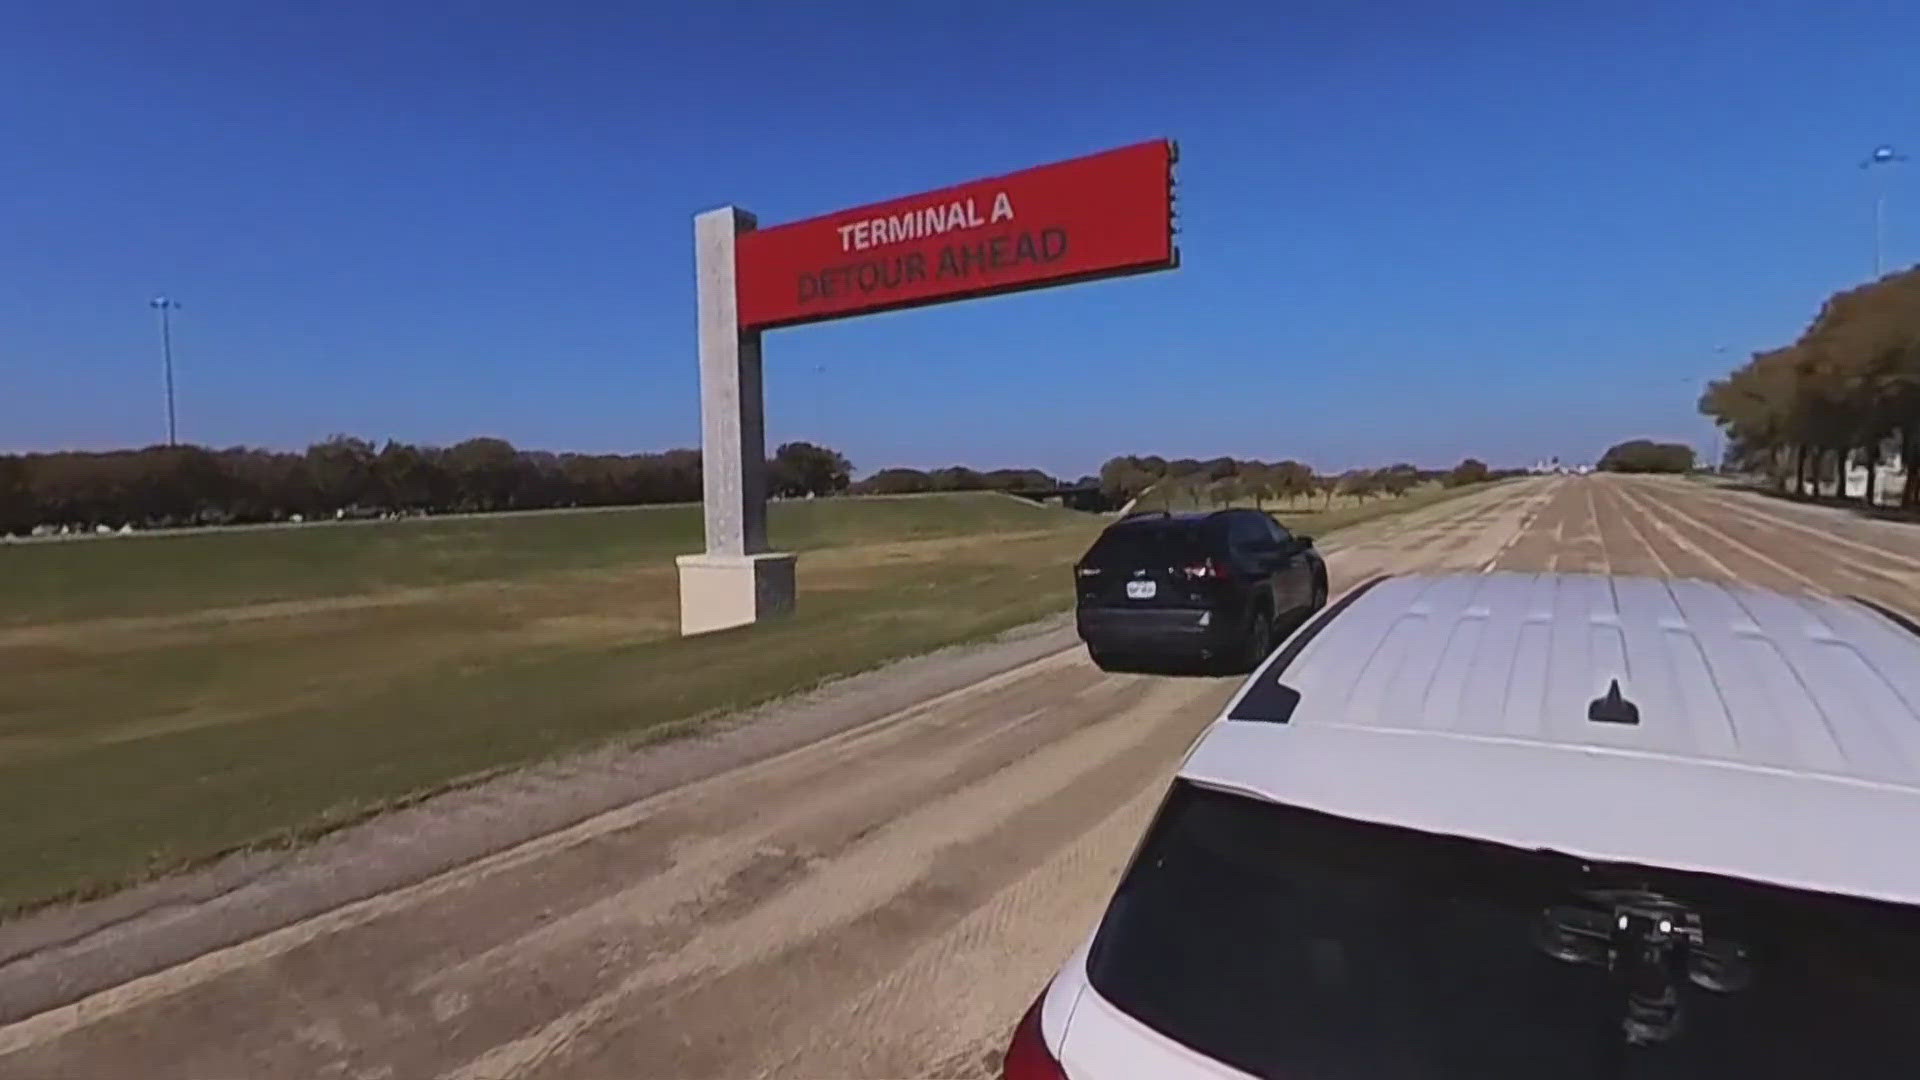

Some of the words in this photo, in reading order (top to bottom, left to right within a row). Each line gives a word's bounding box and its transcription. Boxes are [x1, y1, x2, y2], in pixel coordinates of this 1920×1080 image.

[838, 198, 983, 251] TERMINAL
[991, 192, 1013, 222] A
[798, 253, 927, 301] DETOUR
[937, 228, 1067, 279] AHEAD
